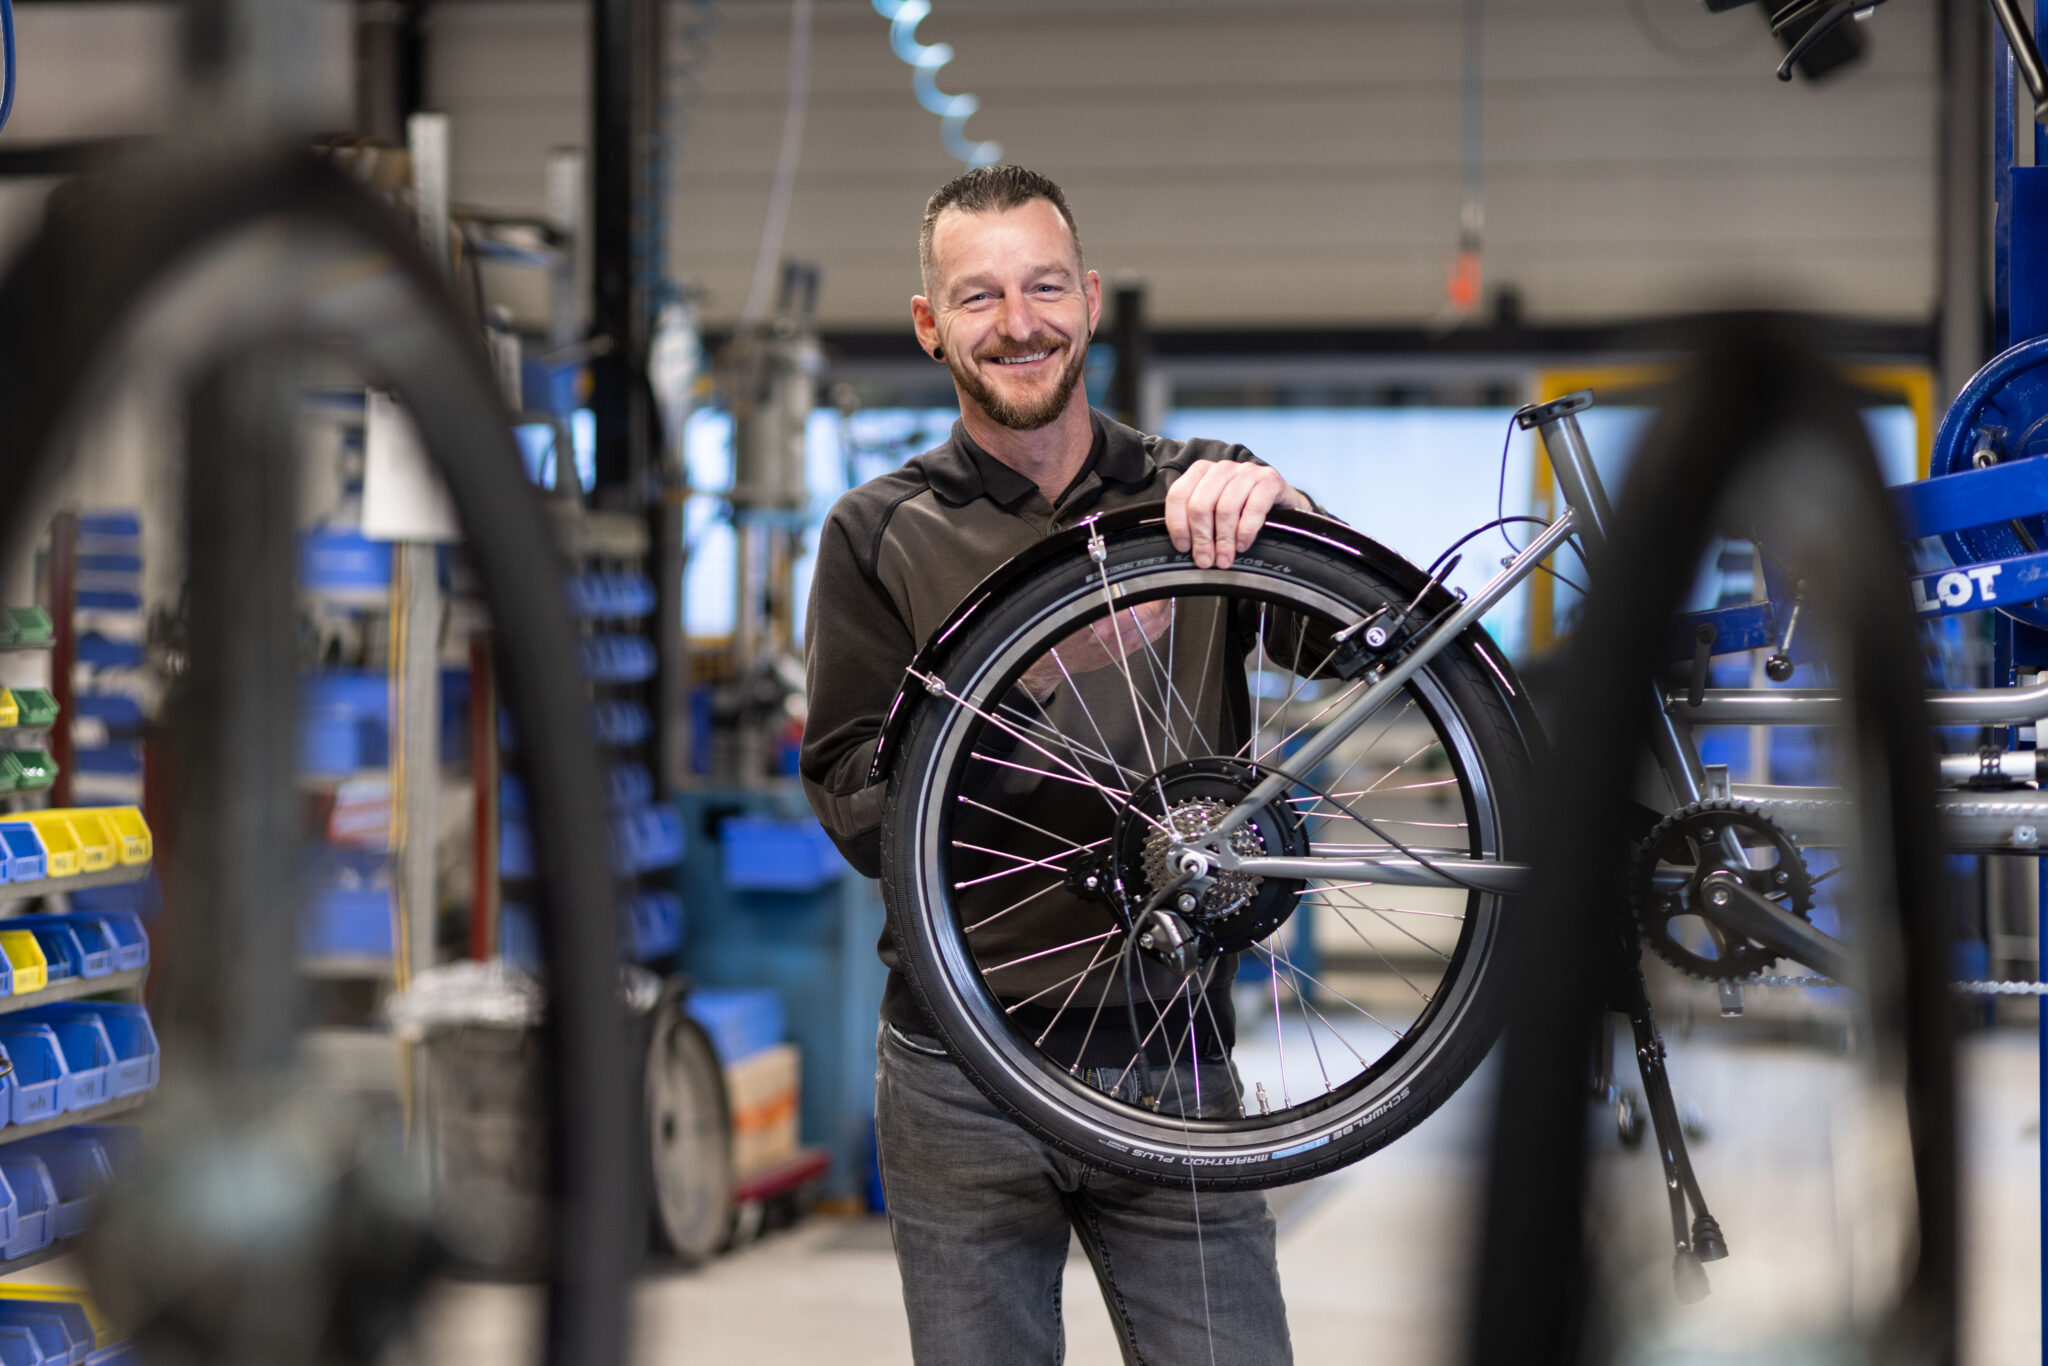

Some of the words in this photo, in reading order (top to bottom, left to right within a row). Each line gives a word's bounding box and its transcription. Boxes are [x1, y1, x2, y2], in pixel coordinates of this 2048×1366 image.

[1332, 1086, 1410, 1141] SCHWALBE
[1131, 1149, 1175, 1164] PLUS
[1182, 1153, 1268, 1166] MARATHON
